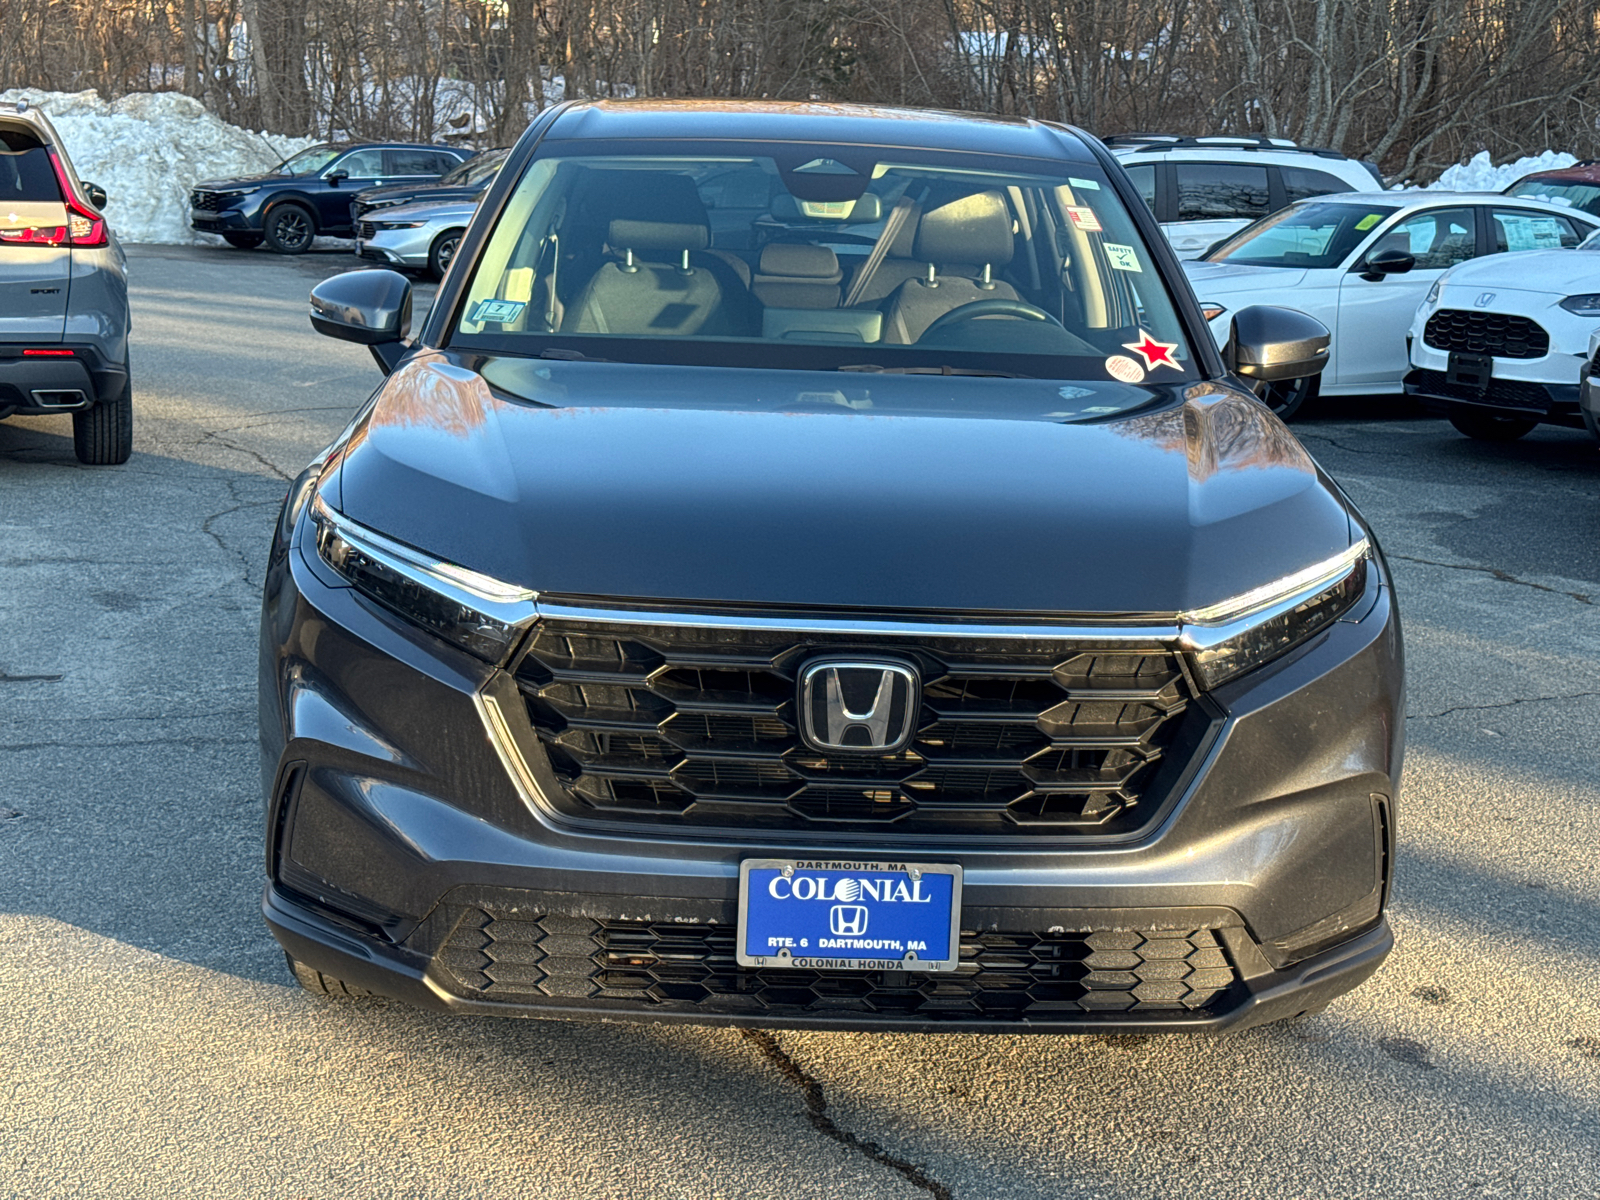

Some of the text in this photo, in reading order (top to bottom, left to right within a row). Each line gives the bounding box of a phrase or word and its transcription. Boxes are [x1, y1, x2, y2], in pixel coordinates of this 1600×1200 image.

[1108, 246, 1132, 254] SAFETY
[888, 863, 908, 871] MA
[768, 876, 932, 903] COLONIAL
[768, 937, 927, 951] RTE. 6 DARTMOUTH, MA
[791, 958, 904, 970] COLONIAL HONDA
